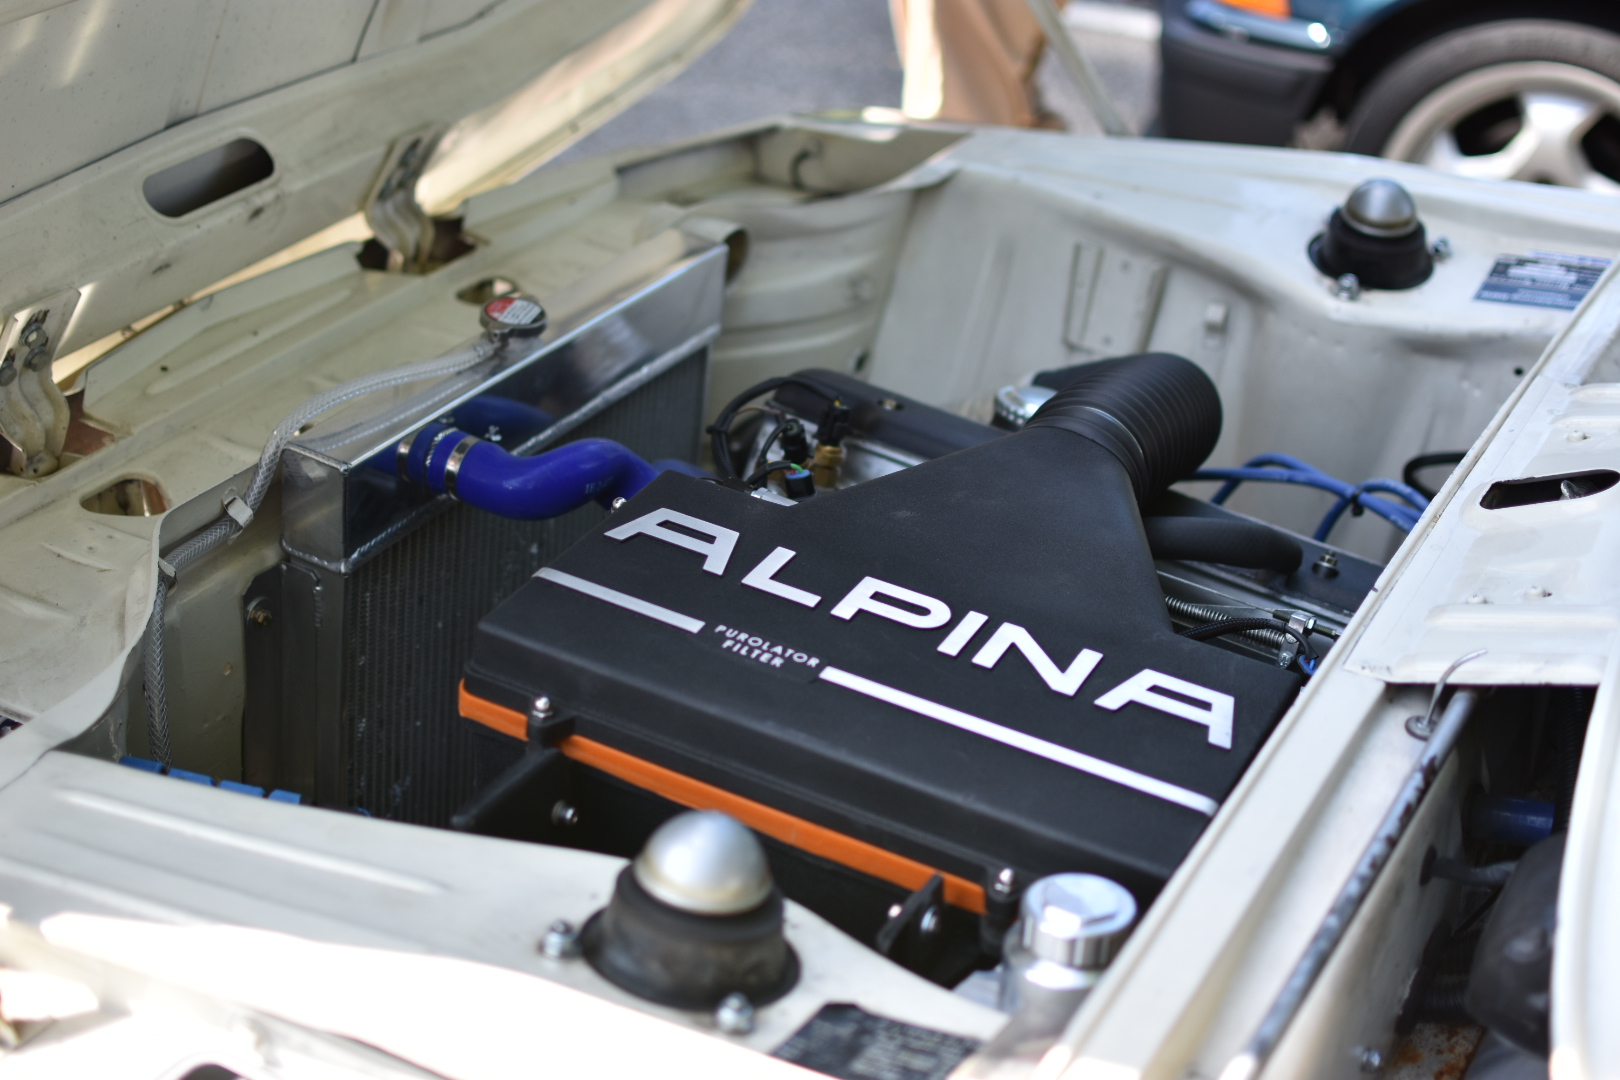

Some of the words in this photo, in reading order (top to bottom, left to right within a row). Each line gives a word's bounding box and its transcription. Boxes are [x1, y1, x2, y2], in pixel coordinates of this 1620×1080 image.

[604, 507, 1236, 750] ALPINA
[714, 624, 820, 668] PUROLATOR
[722, 639, 784, 668] FILTER
